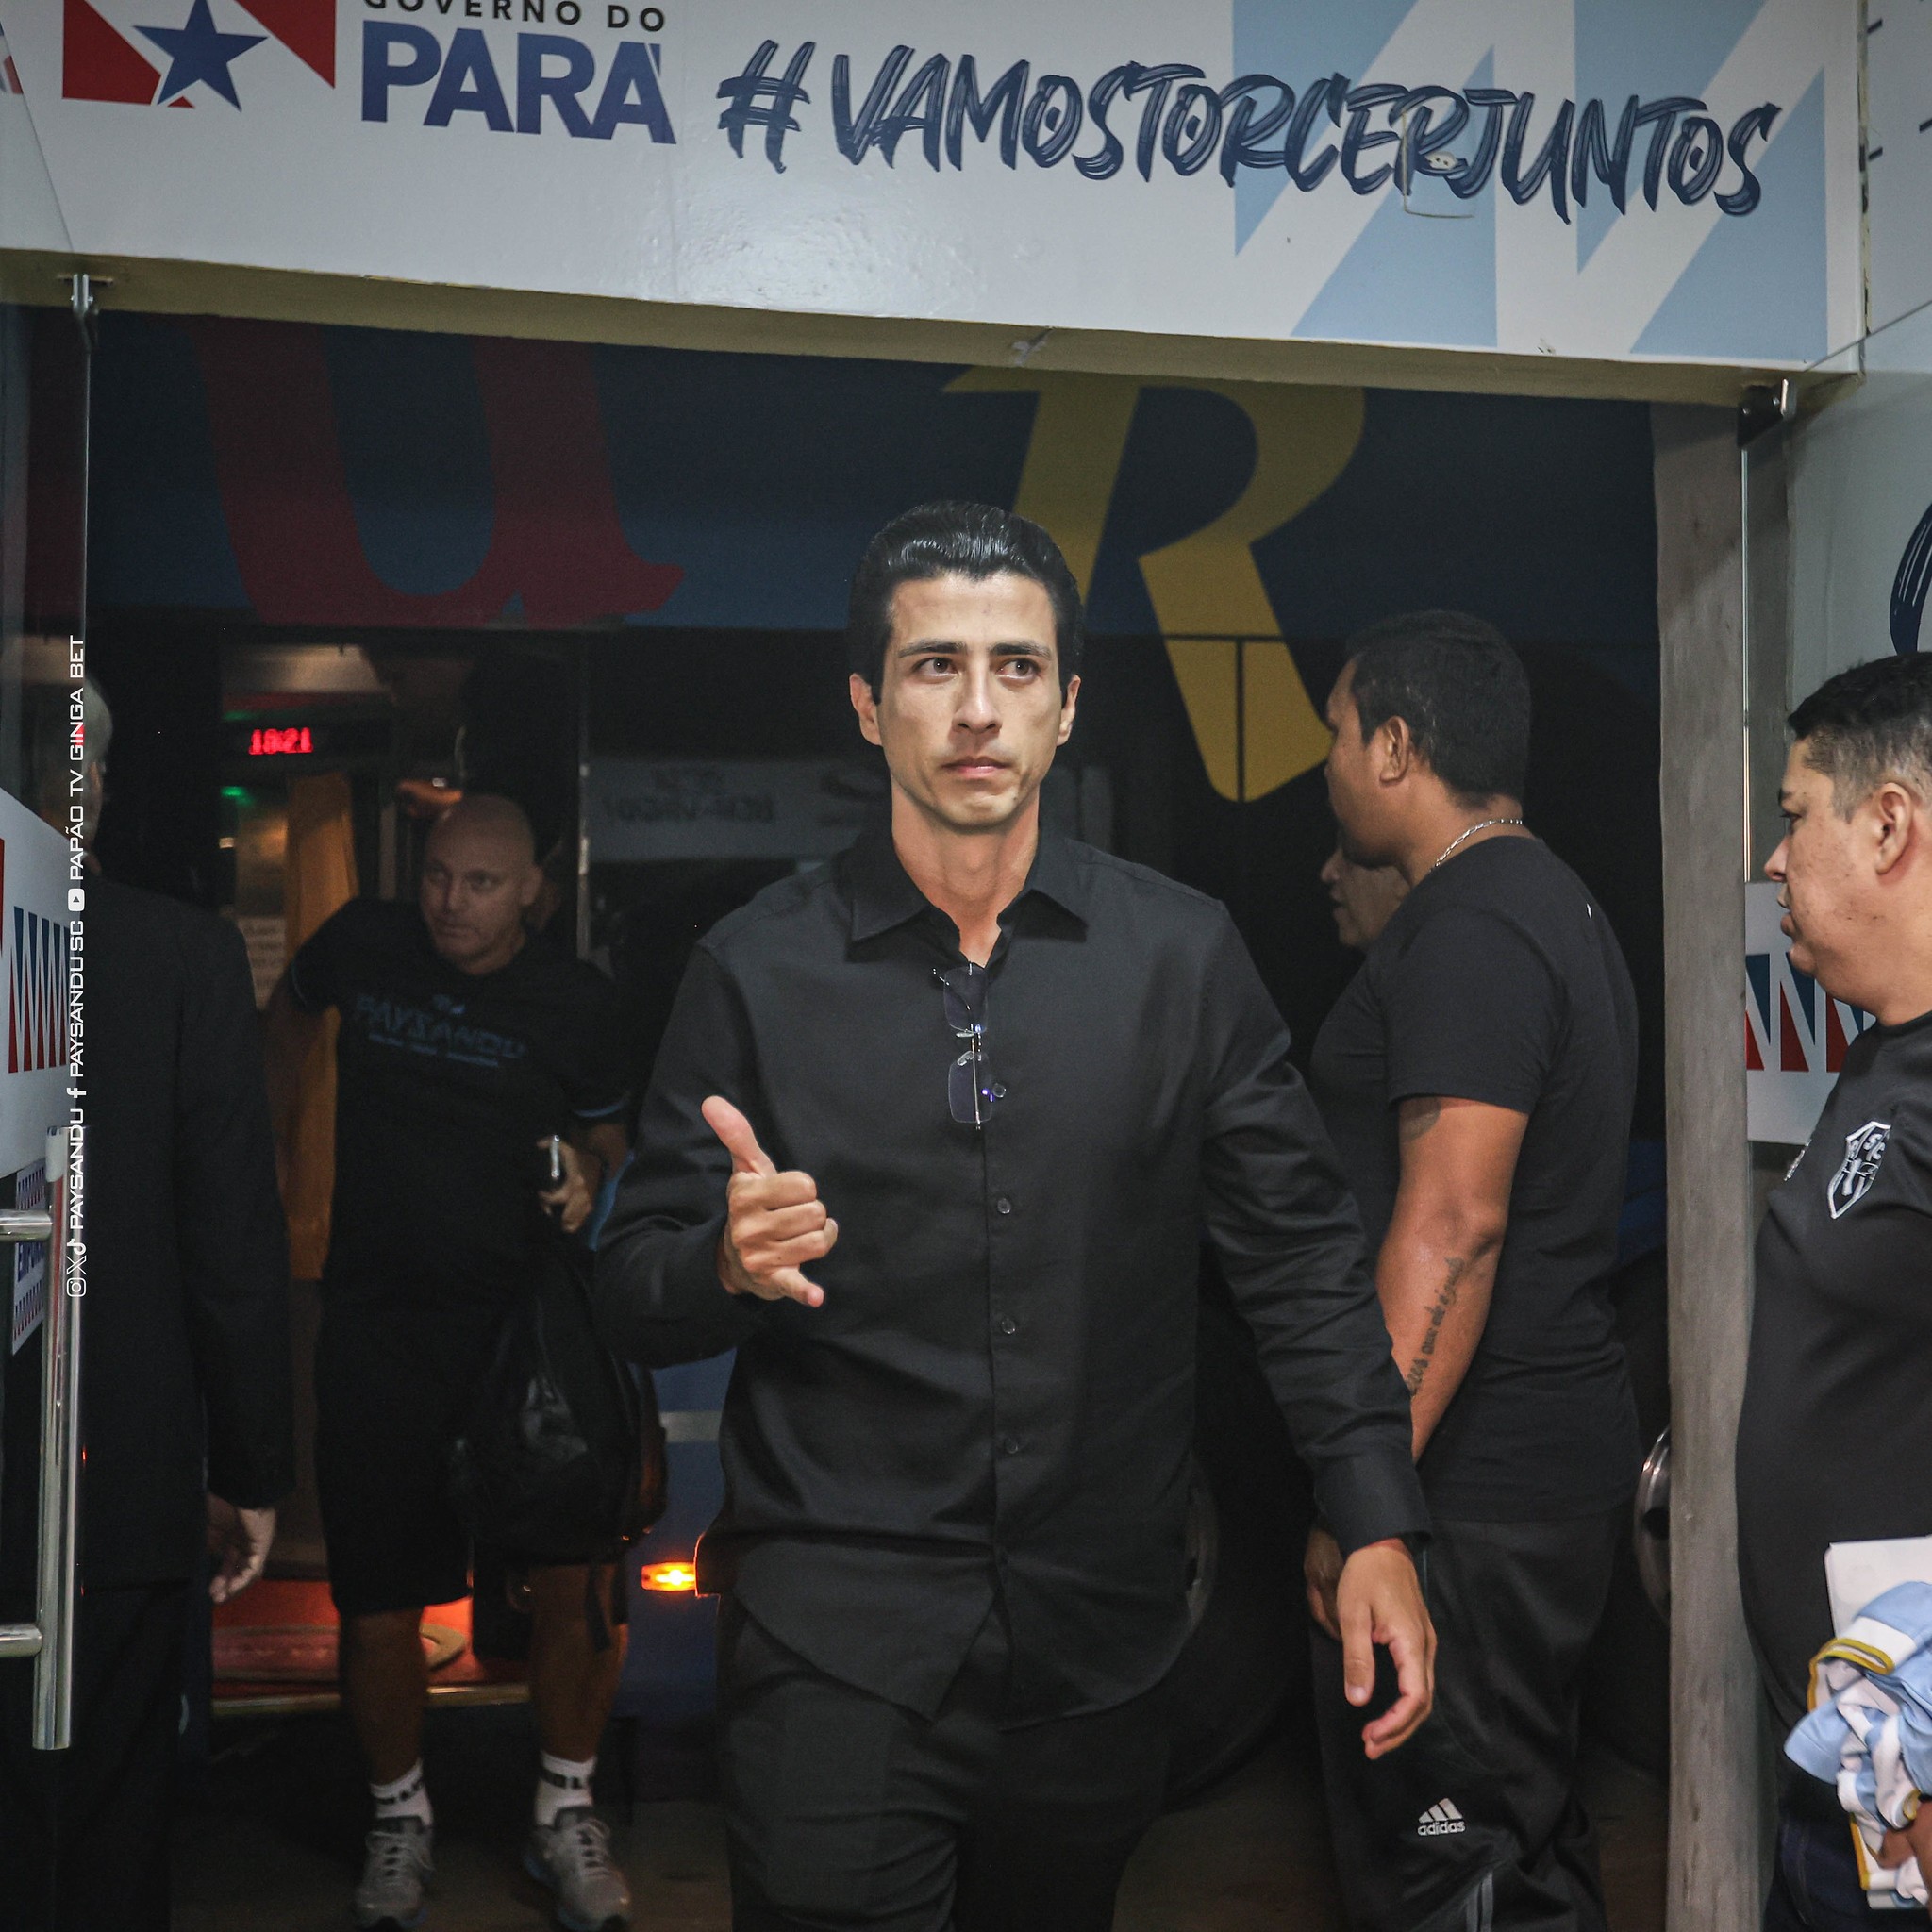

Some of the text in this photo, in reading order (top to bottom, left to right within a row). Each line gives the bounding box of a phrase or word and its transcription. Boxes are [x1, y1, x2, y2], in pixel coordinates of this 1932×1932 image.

[607, 5, 665, 32] DO
[714, 38, 1783, 225] #VAMOSTORCERJUNTOS
[1417, 1821, 1466, 1836] adidas
